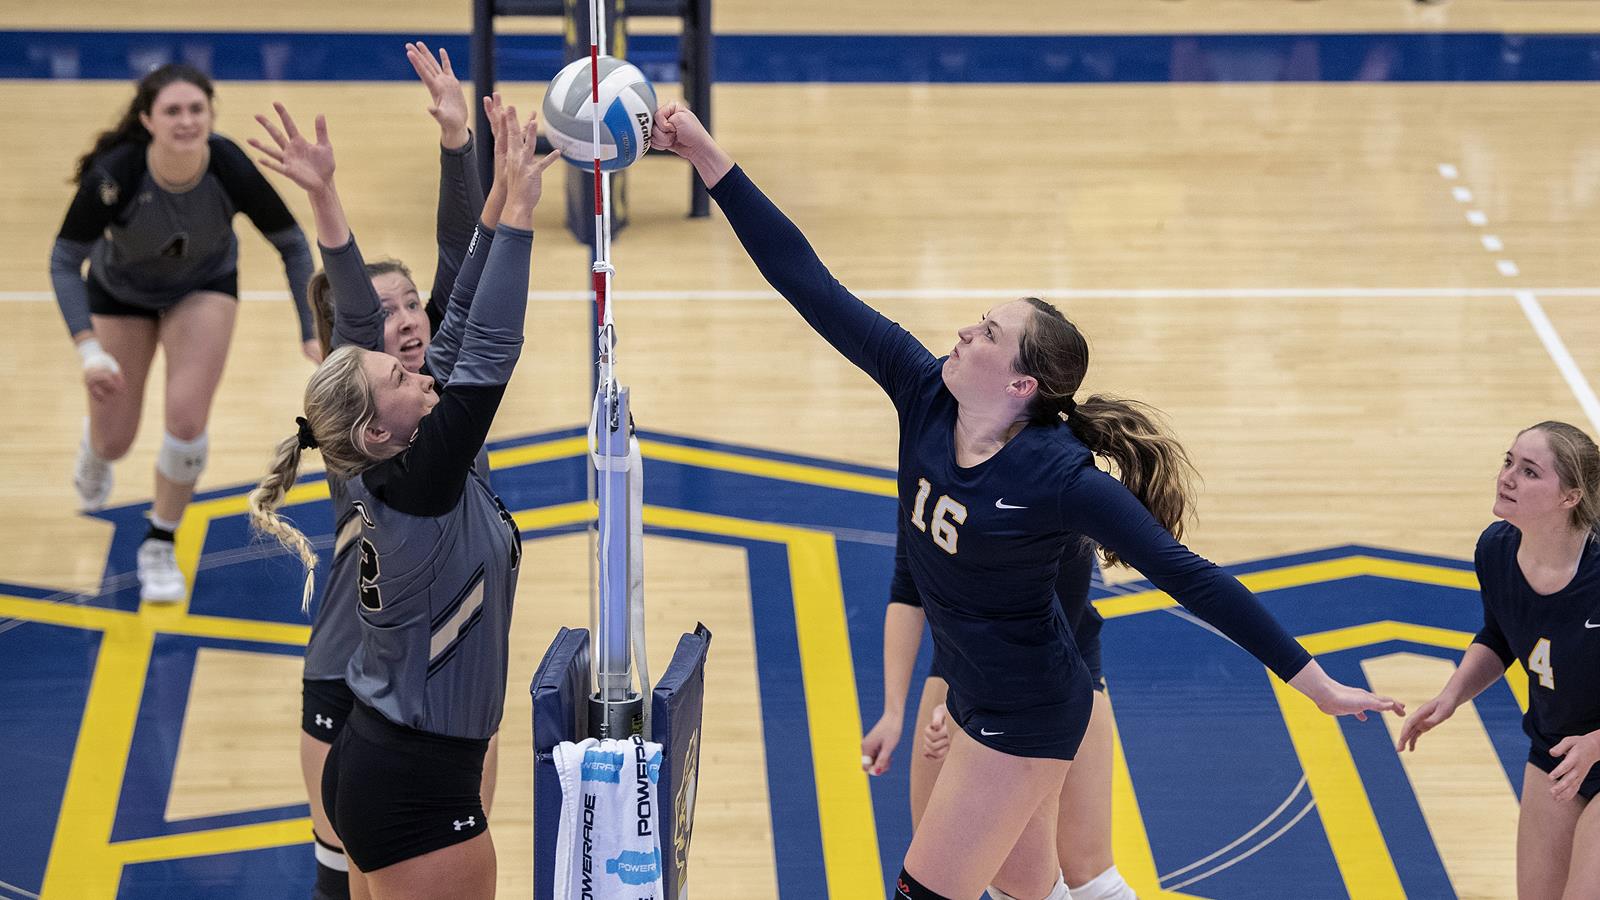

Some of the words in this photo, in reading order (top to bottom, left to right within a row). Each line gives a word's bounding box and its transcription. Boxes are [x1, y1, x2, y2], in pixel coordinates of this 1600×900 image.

[911, 477, 968, 555] 16
[358, 537, 382, 612] 2
[1528, 637, 1555, 690] 4
